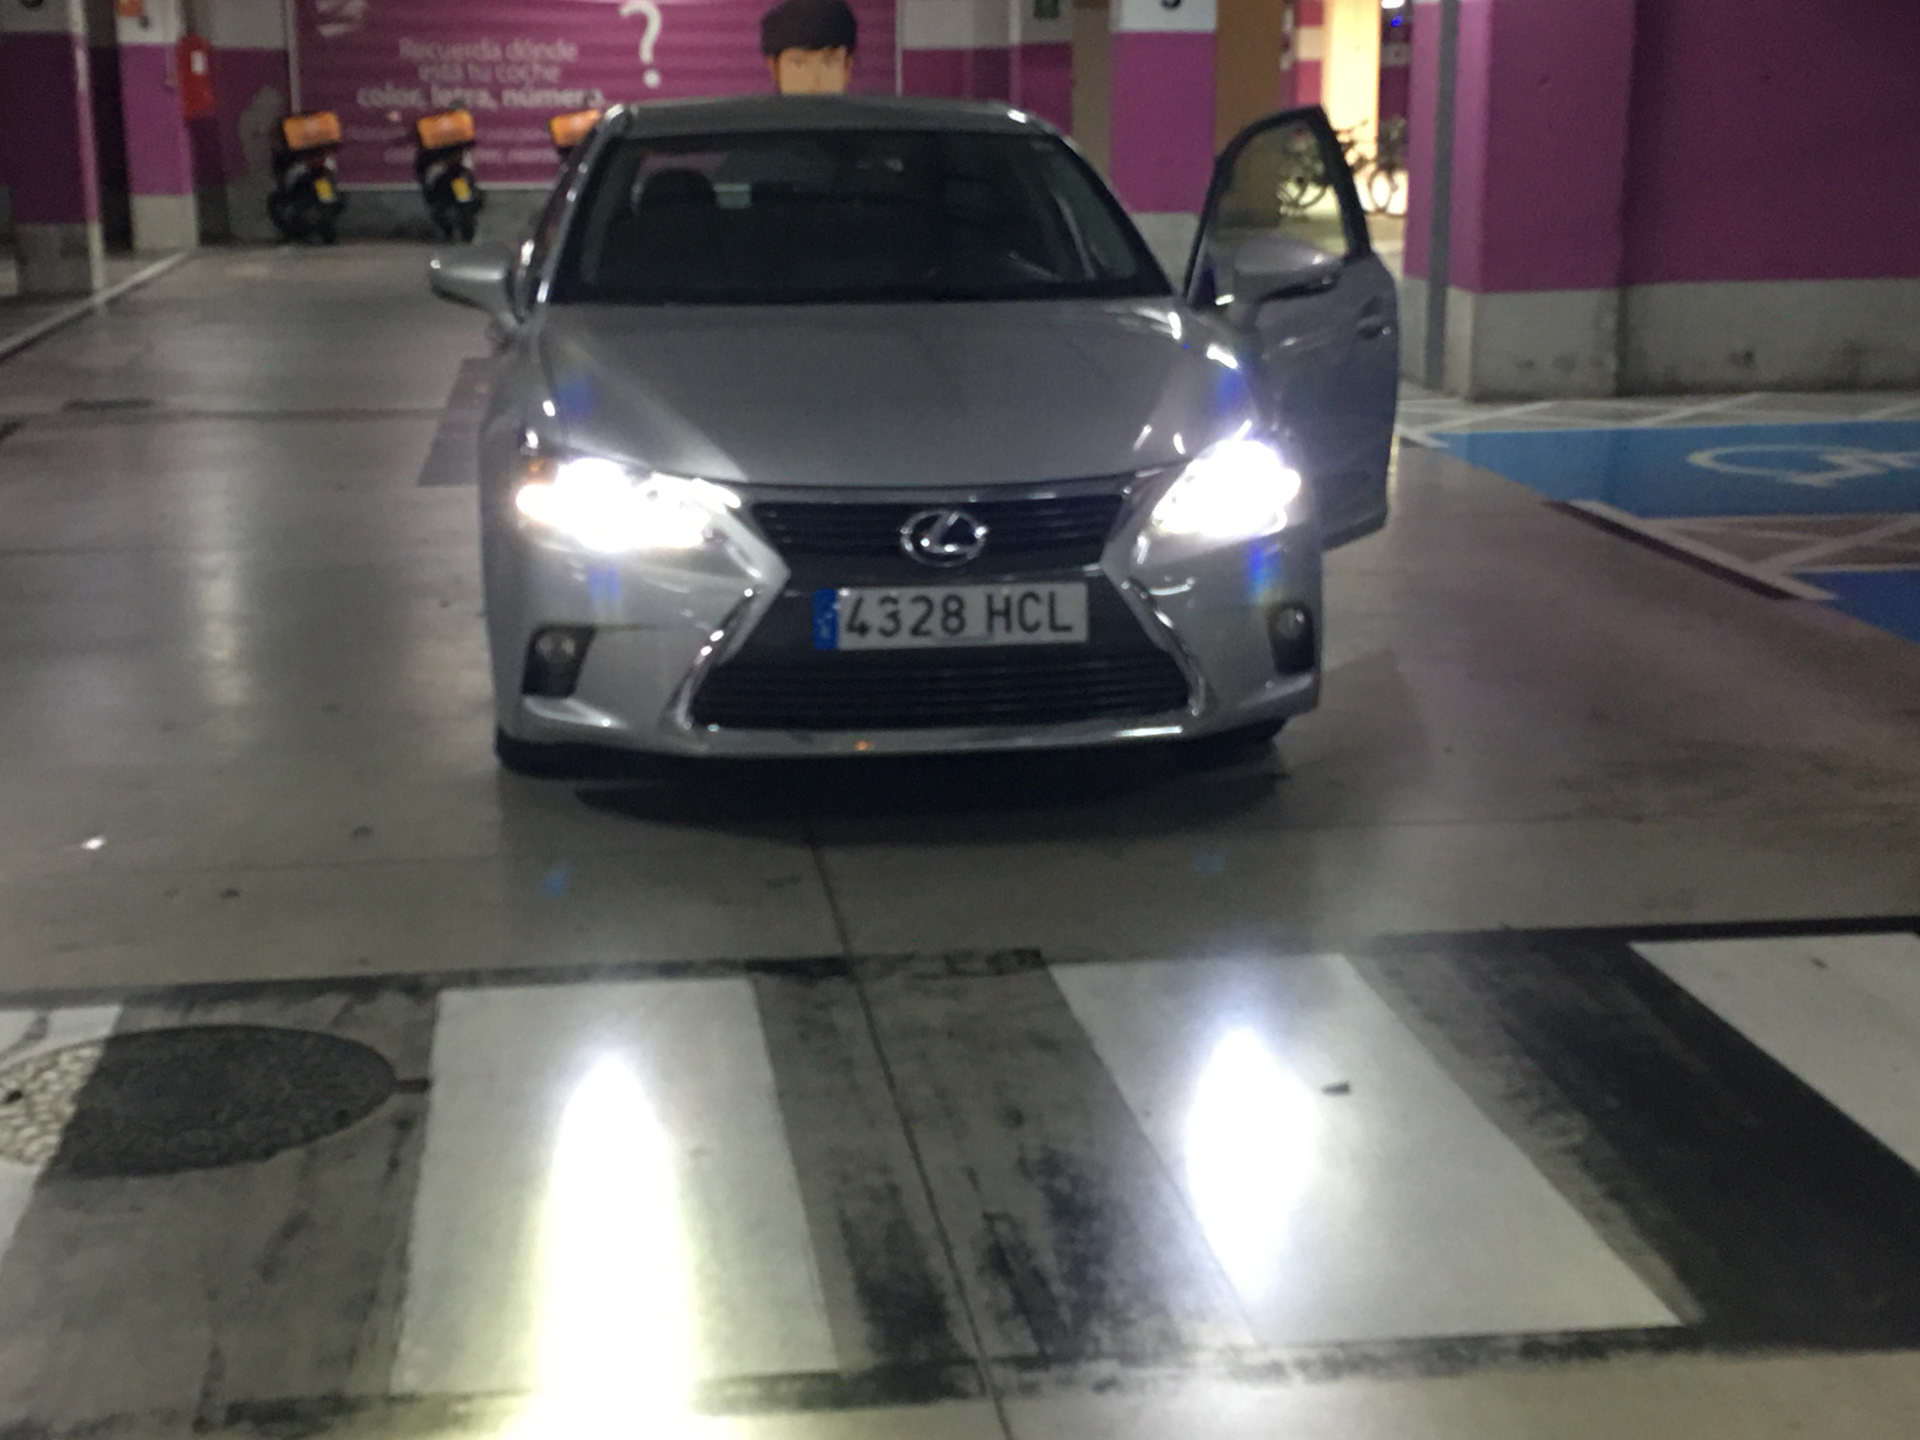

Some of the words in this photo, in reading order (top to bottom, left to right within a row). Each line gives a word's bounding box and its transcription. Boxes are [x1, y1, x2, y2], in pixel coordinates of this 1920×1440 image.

[399, 37, 502, 61] Recuerda
[495, 61, 562, 82] coche
[846, 594, 966, 638] 4328
[986, 591, 1073, 635] HCL
